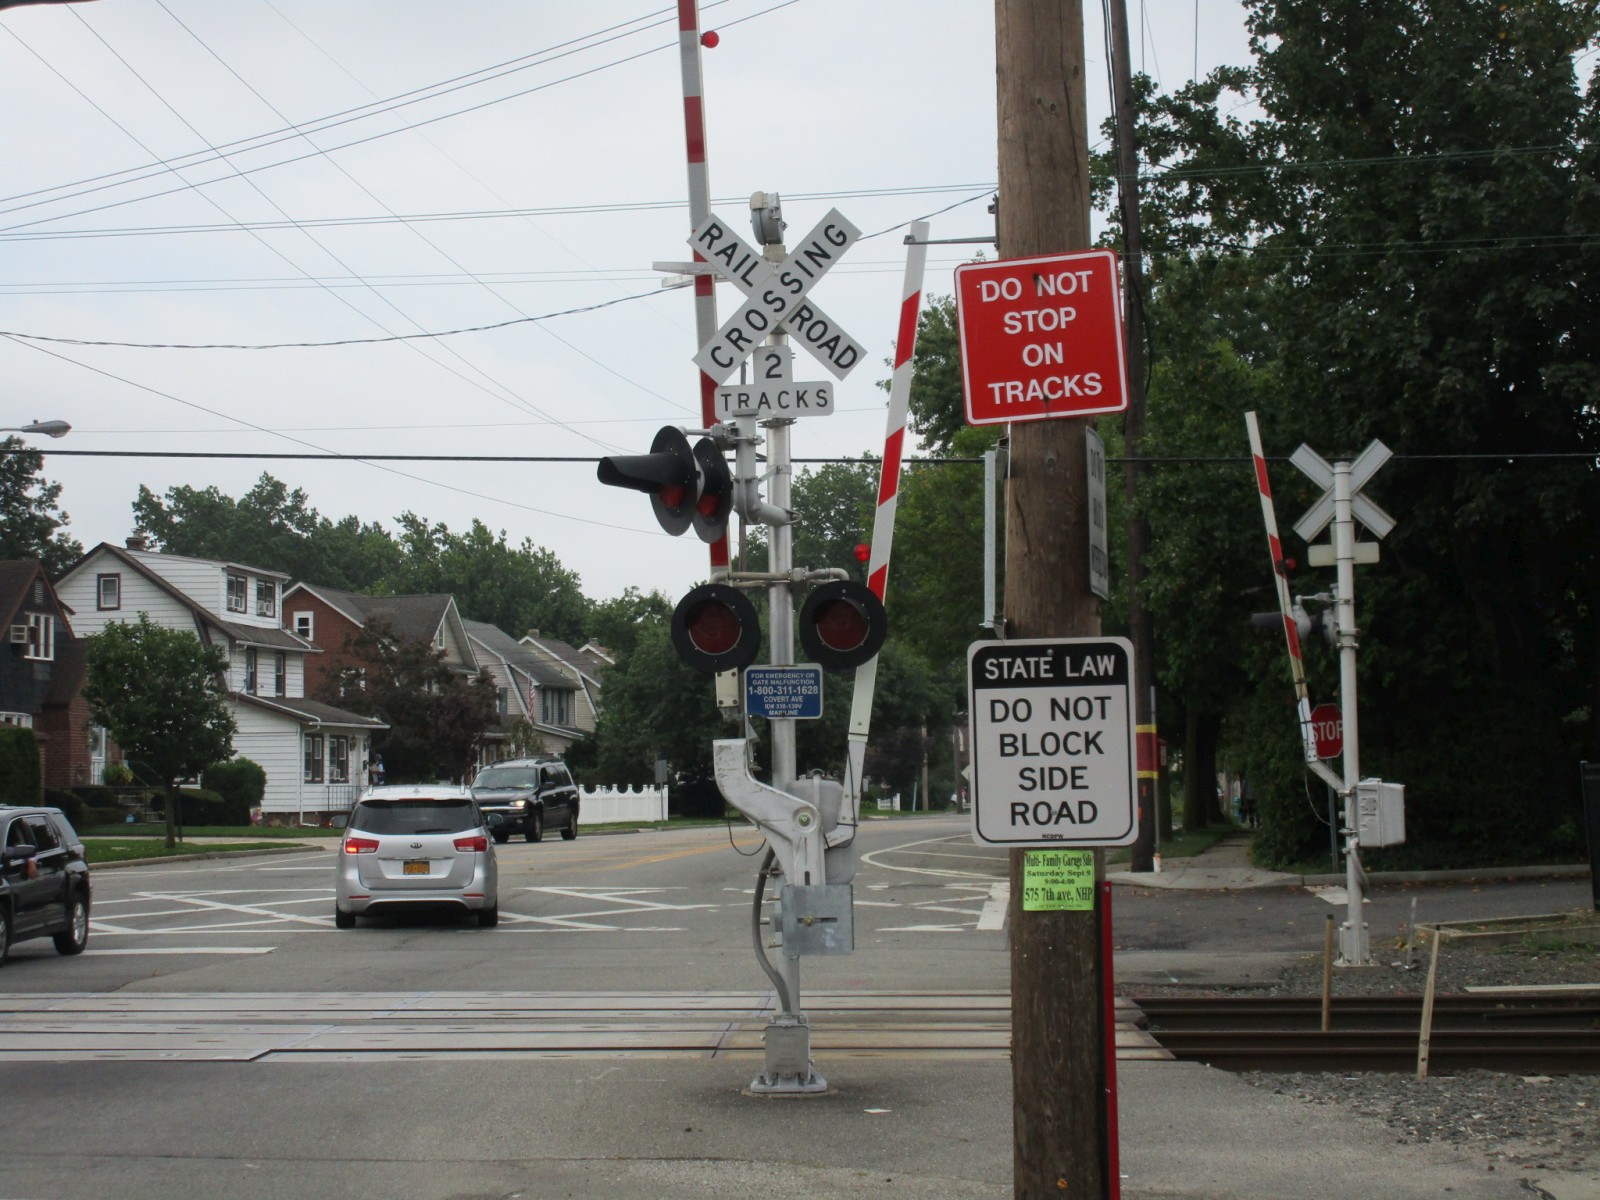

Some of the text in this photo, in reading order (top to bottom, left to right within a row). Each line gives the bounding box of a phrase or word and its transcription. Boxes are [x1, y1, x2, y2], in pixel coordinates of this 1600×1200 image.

[698, 222, 858, 369] RAIL ROAD
[710, 224, 848, 369] CROSSING
[981, 270, 1093, 303] DO NOT
[1003, 306, 1076, 335] STOP
[765, 353, 782, 379] 2
[1022, 342, 1064, 367] ON
[720, 389, 828, 412] TRACKS
[987, 372, 1102, 404] TRACKS
[984, 655, 1115, 680] STATE LAW
[748, 686, 819, 695] 1-800-311-1628
[763, 695, 803, 703] COVERT AVE
[990, 696, 1112, 723] DO NOT
[1312, 720, 1343, 742] STOP
[1000, 731, 1104, 757] BLOCK
[1018, 766, 1089, 791] SIDE
[1010, 800, 1098, 826] ROAD
[1042, 854, 1062, 870] Family
[1067, 870, 1084, 878] Sept
[1024, 887, 1093, 903] 575 7th ave, NHP
